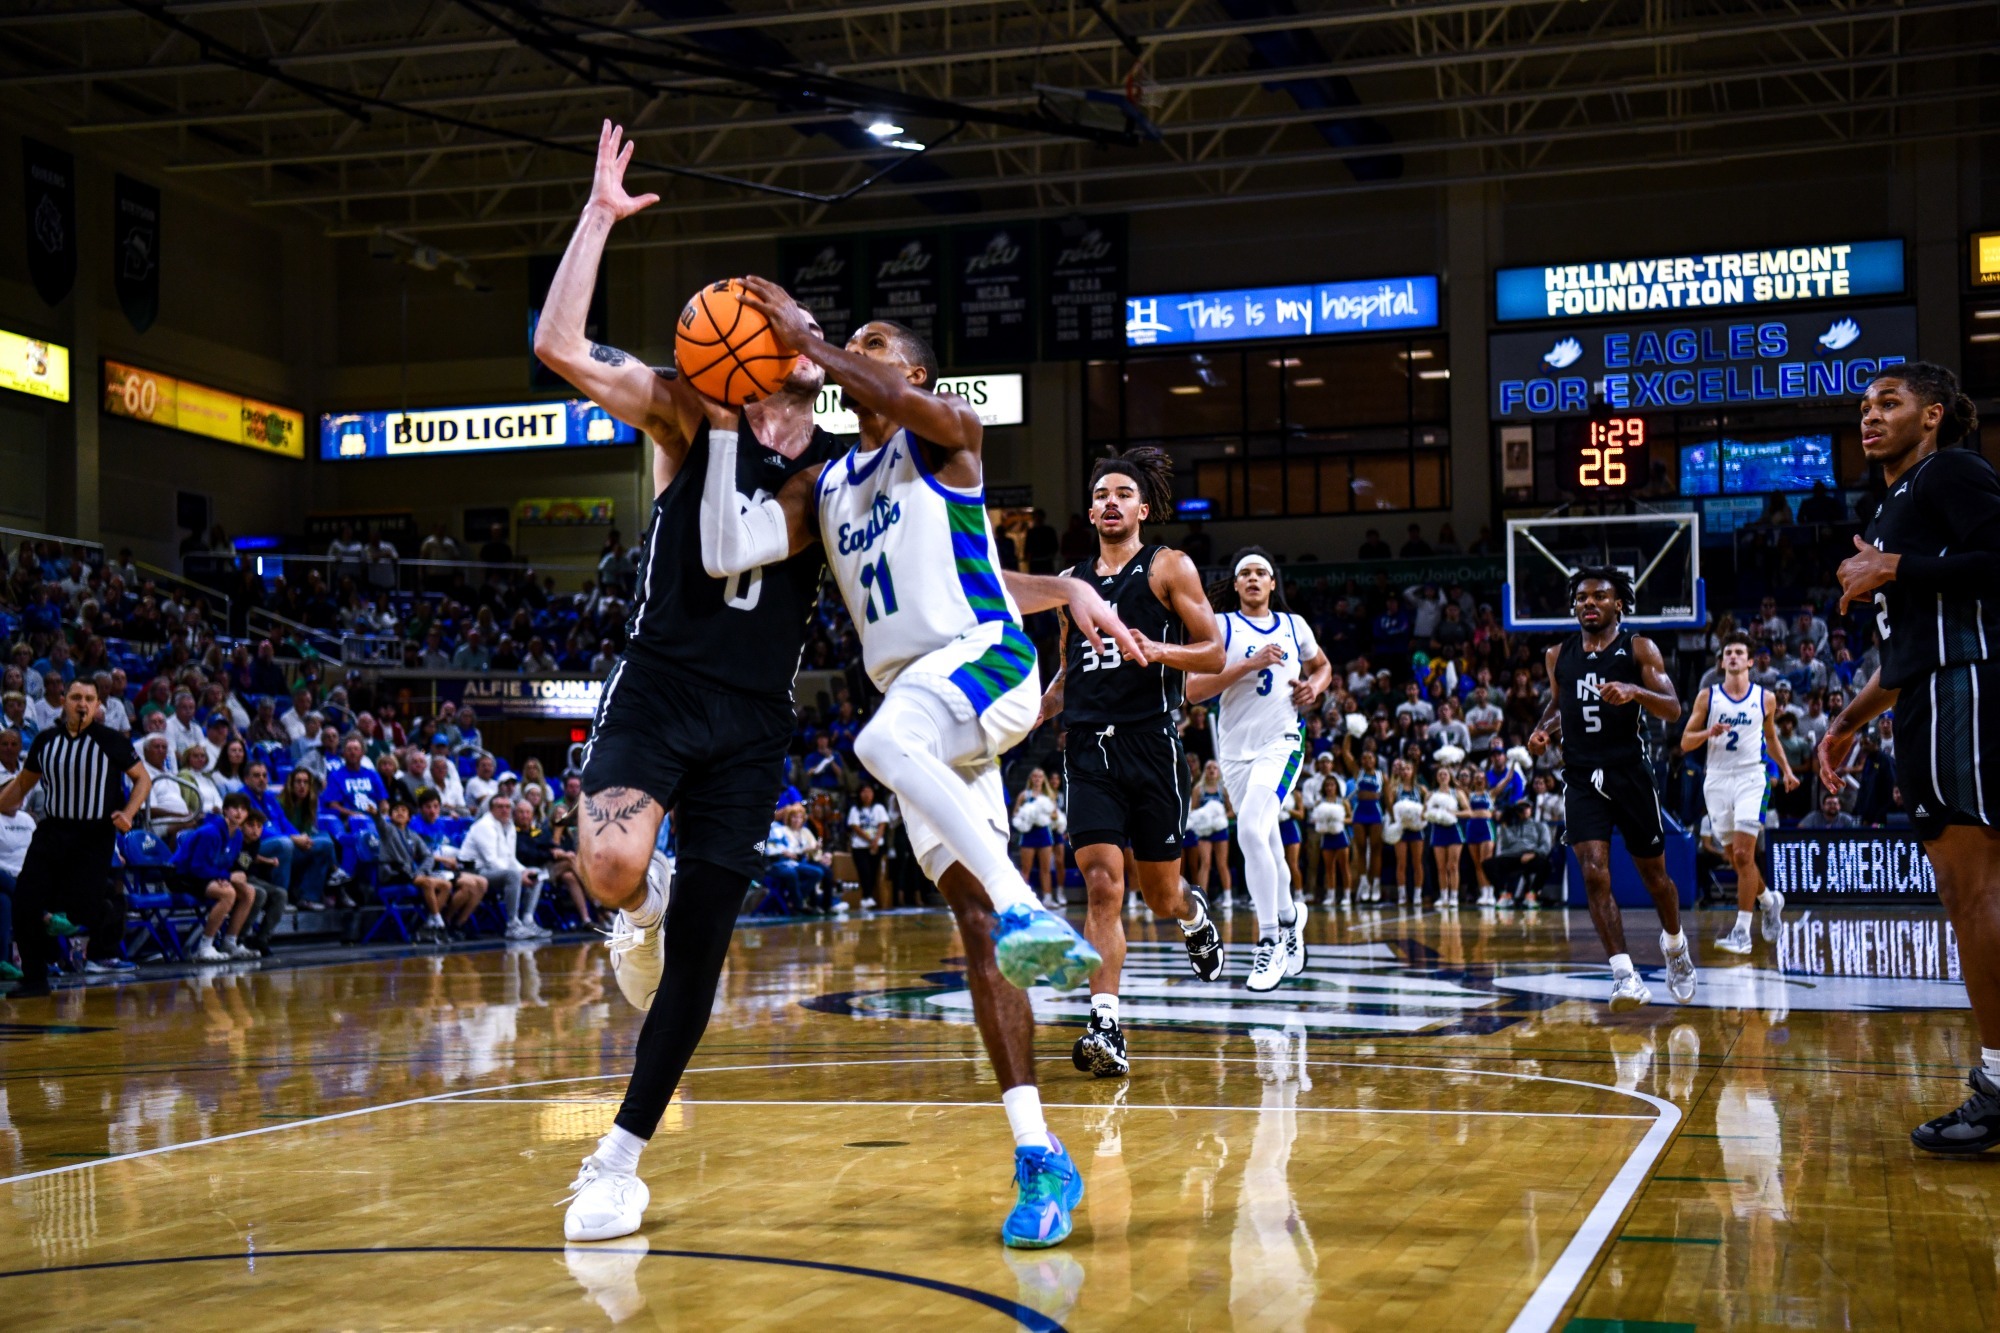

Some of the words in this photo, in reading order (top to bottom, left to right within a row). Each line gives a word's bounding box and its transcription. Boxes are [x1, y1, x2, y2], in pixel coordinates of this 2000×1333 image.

[1545, 245, 1851, 291] HILLMYER-TREMONT
[1178, 298, 1235, 329] This
[1245, 296, 1266, 327] is
[1276, 298, 1313, 335] my
[1321, 280, 1418, 328] hospital.
[1547, 278, 1744, 316] FOUNDATION
[1752, 270, 1850, 301] SUITE
[1604, 322, 1789, 369] EAGLES
[124, 373, 157, 420] 60
[1500, 377, 1588, 415] FOR
[394, 418, 458, 444] BUD
[466, 413, 558, 440] LIGHT
[1591, 418, 1644, 447] 1:29
[1579, 447, 1627, 487] 26
[860, 551, 899, 625] 11
[1874, 592, 1892, 641] 2
[1081, 637, 1122, 672] 33
[464, 681, 521, 697] ALFIE
[1256, 668, 1274, 697] 3
[1582, 705, 1602, 733] 5
[1726, 731, 1739, 751] 2
[1773, 841, 1822, 893] NTIC
[1826, 839, 1937, 893] AMERICAN
